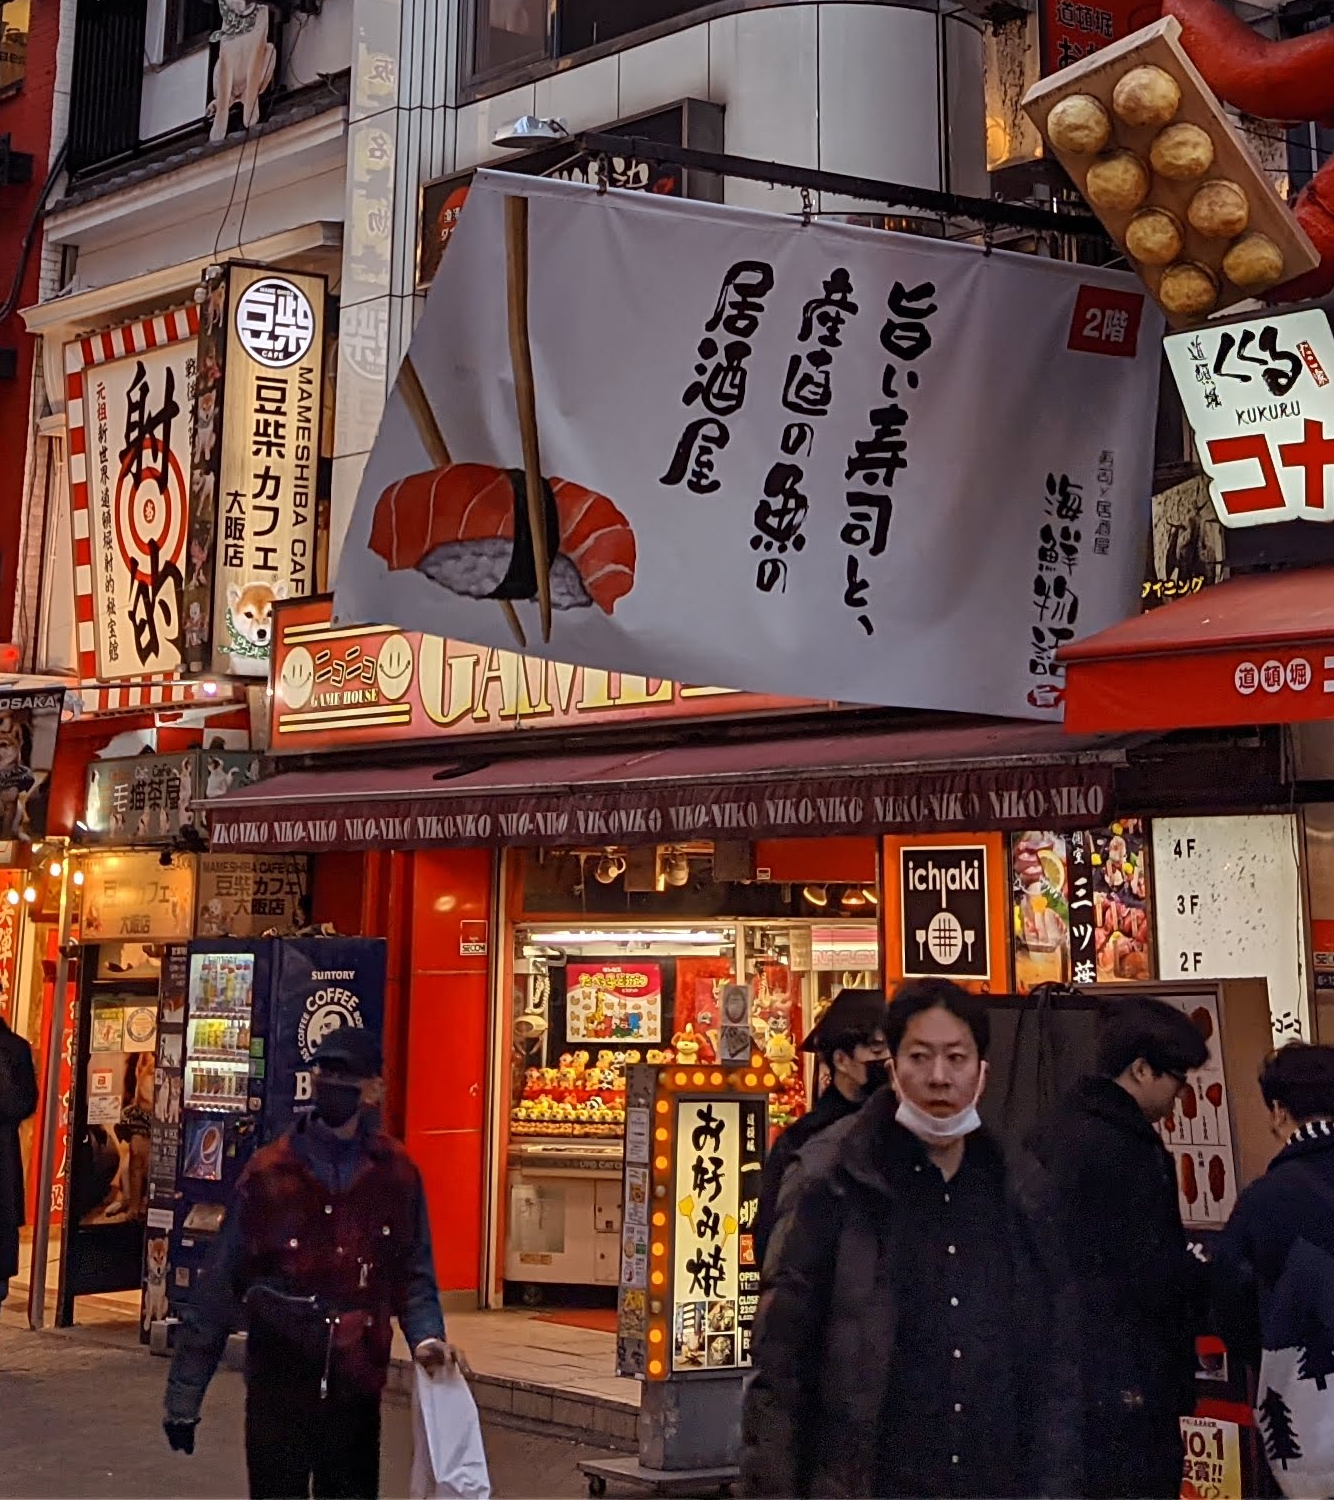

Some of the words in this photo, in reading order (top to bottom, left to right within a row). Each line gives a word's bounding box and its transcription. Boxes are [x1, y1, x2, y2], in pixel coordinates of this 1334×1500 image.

[1081, 307, 1127, 343] 2階
[261, 351, 284, 360] CAFE
[660, 260, 774, 495] 居酒屋
[1234, 401, 1302, 427] KUKURU
[752, 268, 859, 594] 産直の魚の
[292, 366, 313, 526] MAMESHIBA
[252, 375, 288, 571] 豆柴カフェ
[119, 360, 183, 668] 射的
[223, 491, 247, 568] 大阪店
[314, 646, 375, 687] ニコニコ
[1236, 659, 1310, 692] 道頓堀
[310, 692, 341, 707] GAME
[343, 689, 378, 706] HOUSE
[272, 820, 337, 843] NIKO-NIKO
[1071, 830, 1085, 866] 個室
[1173, 838, 1196, 860] 4F
[203, 861, 257, 874] MAMESHIBA
[259, 861, 285, 874] CAFE
[215, 874, 299, 897] 豆柴カフェ
[907, 859, 981, 909] ichiaki
[234, 898, 285, 916] 大阪店
[1177, 894, 1199, 916] 3F
[462, 943, 485, 952] SECOM
[1180, 951, 1202, 972] 2F
[311, 970, 355, 980] SUNTORY
[306, 987, 359, 1012] COFFEE
[298, 1013, 309, 1047] COFFEE
[686, 1104, 727, 1299] お好み焼
[739, 1271, 760, 1282] OPEN
